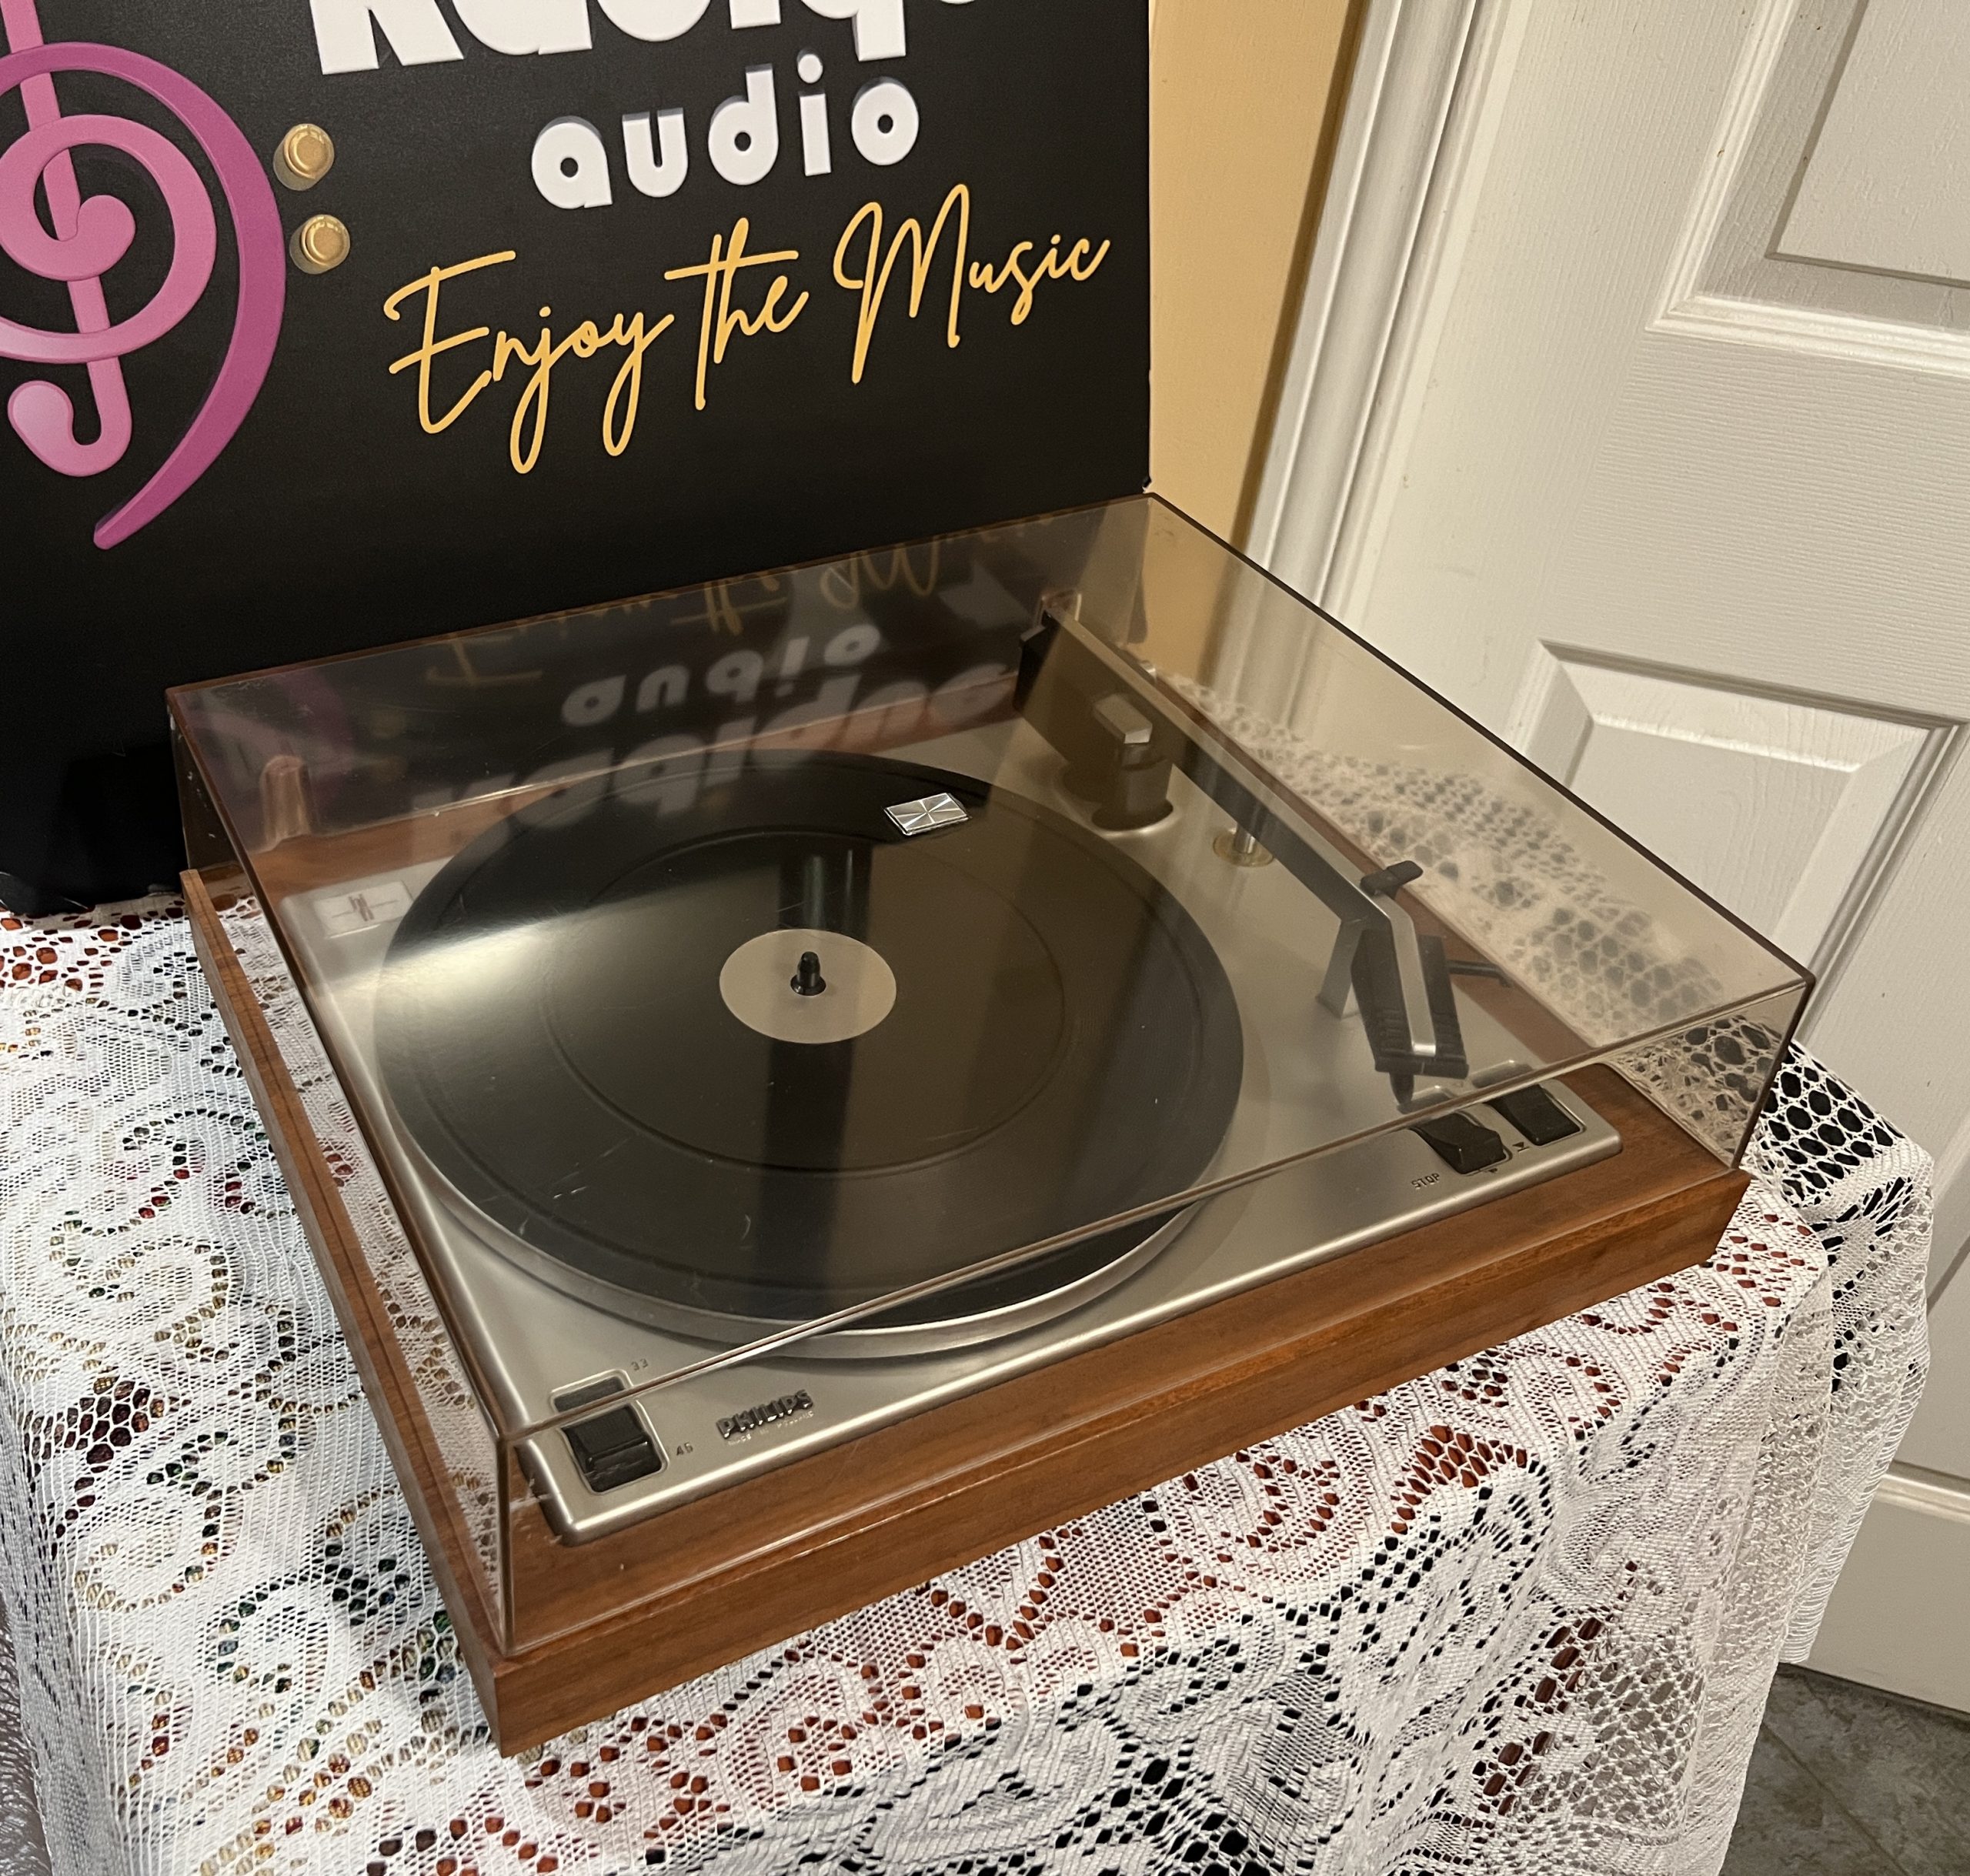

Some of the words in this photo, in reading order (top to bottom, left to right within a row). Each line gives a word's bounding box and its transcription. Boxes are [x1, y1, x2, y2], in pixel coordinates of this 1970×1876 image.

[531, 51, 919, 209] audio
[385, 250, 675, 474] Enjoy
[665, 217, 810, 411] the
[833, 183, 1110, 383] Music
[1411, 1172, 1441, 1190] STOP
[630, 1357, 649, 1371] 33
[716, 1388, 814, 1439] PHILIPS
[676, 1441, 694, 1456] 45
